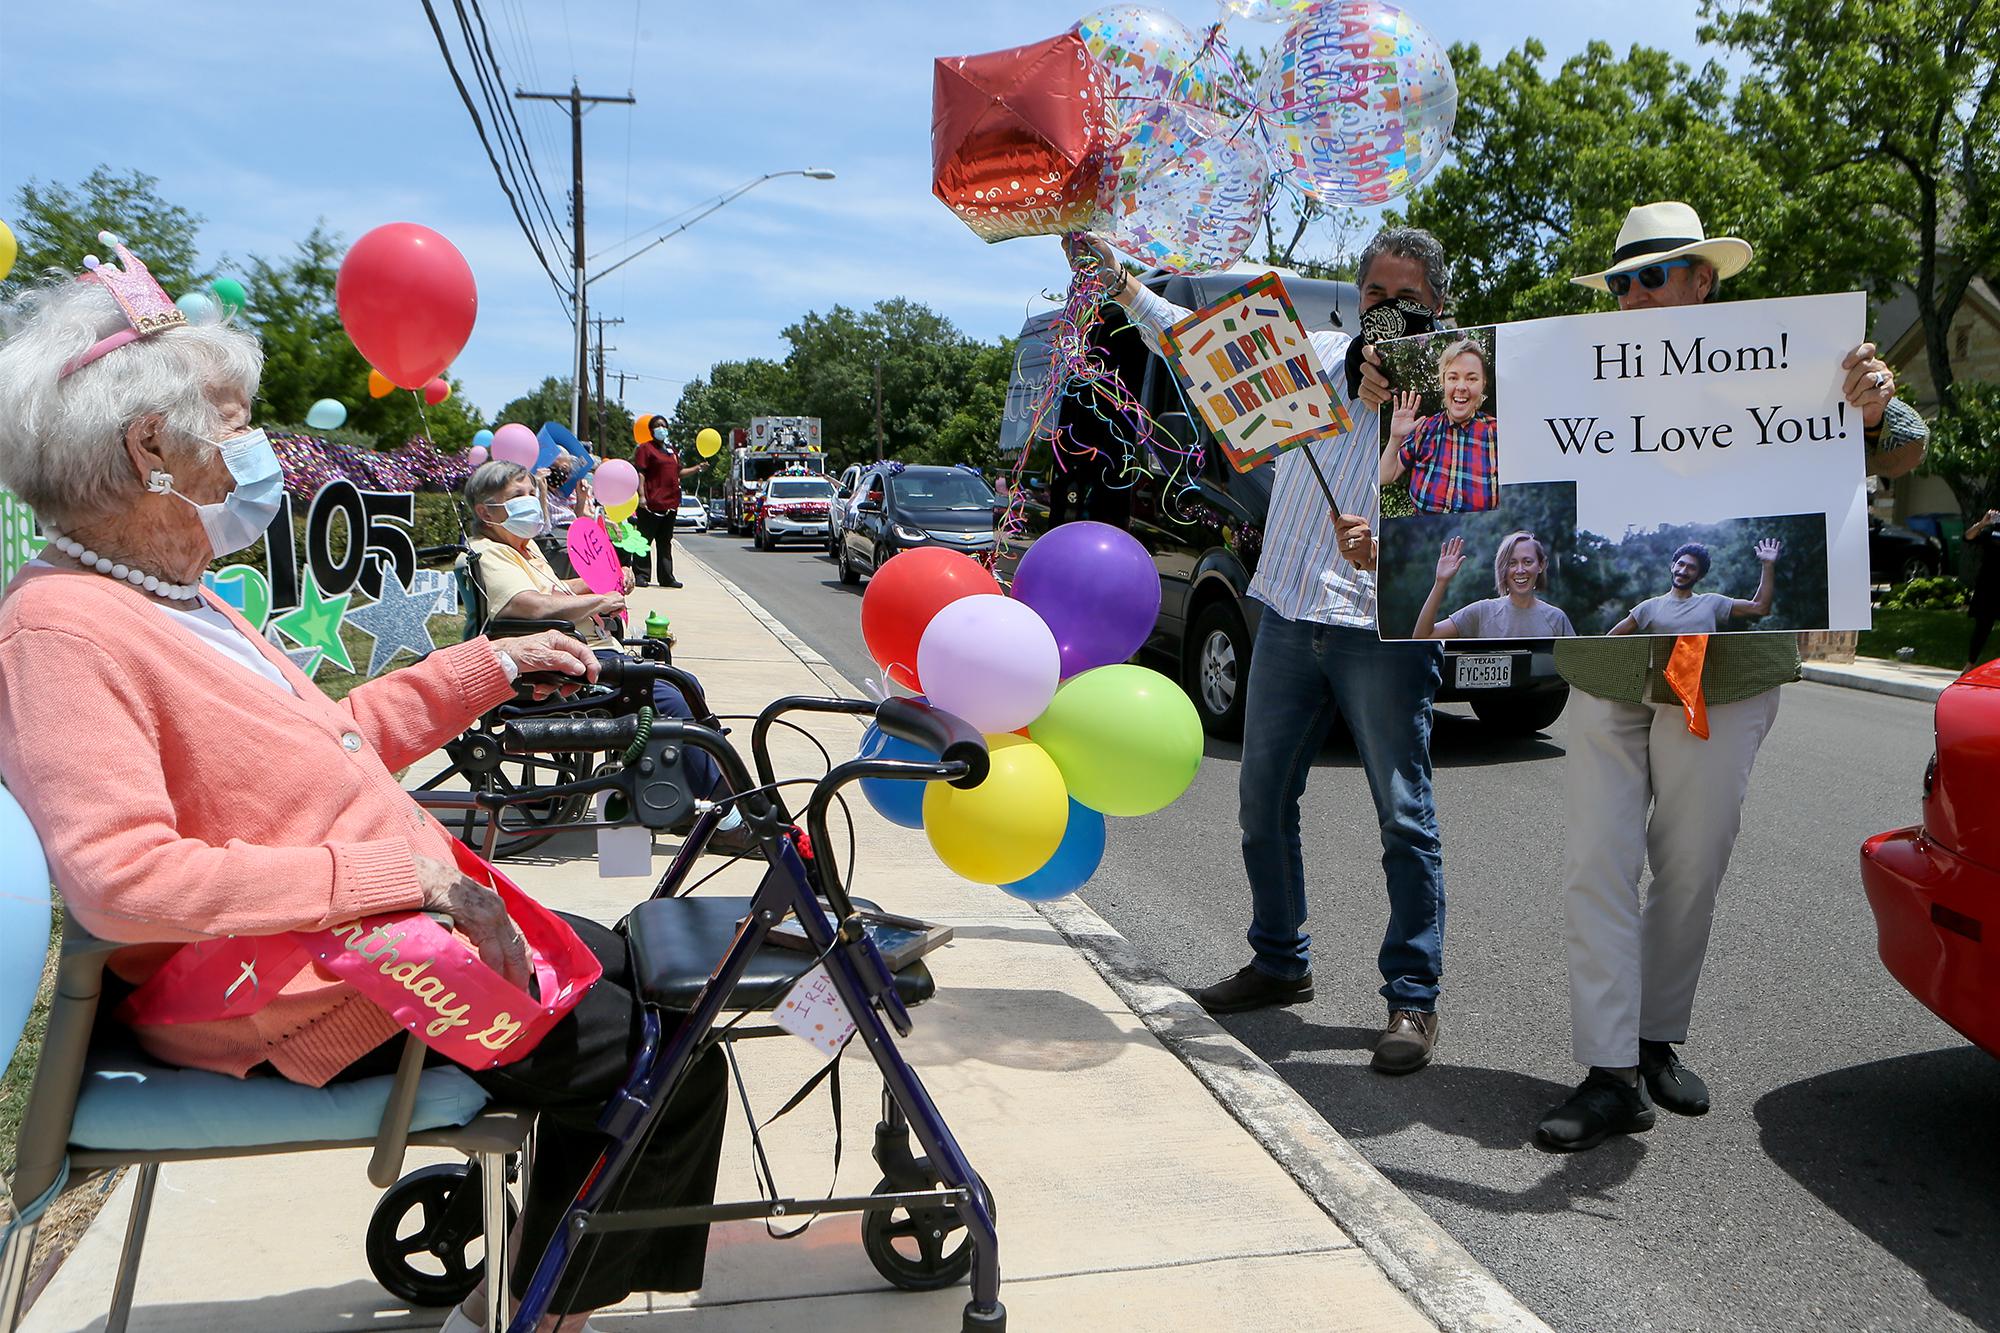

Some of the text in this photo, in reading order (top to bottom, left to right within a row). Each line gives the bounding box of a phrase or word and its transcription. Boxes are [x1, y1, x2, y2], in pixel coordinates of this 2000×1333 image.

[1206, 323, 1282, 383] HAPPY
[1593, 332, 1788, 381] Hi Mom!
[1207, 353, 1317, 426] BIRTHDAY
[1543, 401, 1847, 455] We Love You!
[263, 479, 417, 614] 105
[570, 529, 603, 566] WE
[1474, 657, 1497, 665] TEXAS
[794, 975, 832, 1018] IREN
